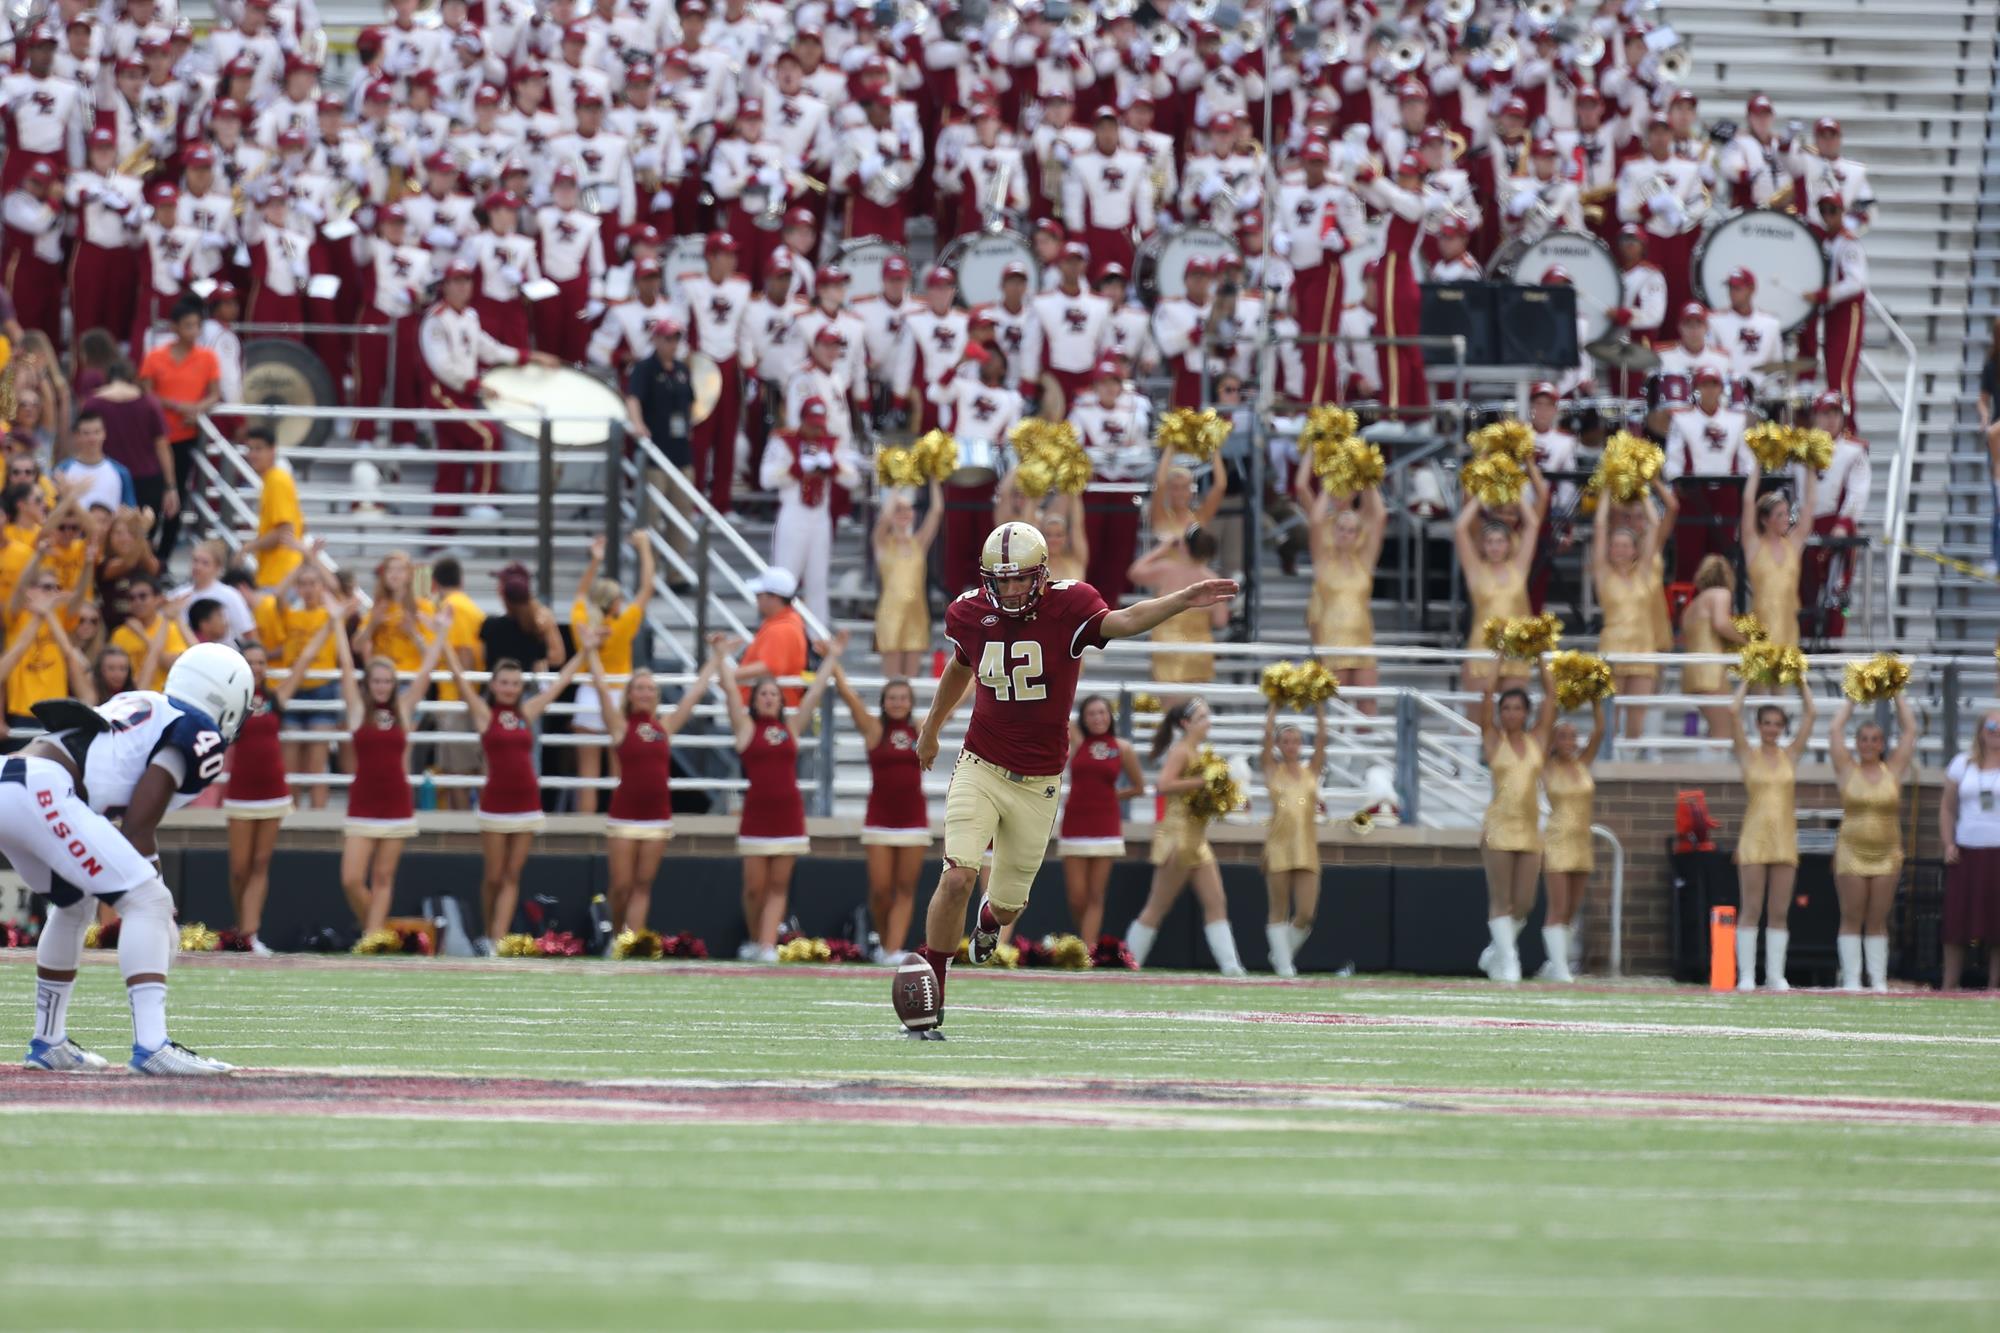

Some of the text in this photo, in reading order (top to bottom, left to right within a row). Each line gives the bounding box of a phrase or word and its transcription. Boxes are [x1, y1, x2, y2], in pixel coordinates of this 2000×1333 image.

[978, 640, 1047, 701] 42
[193, 730, 224, 779] 40
[36, 789, 104, 878] BISON
